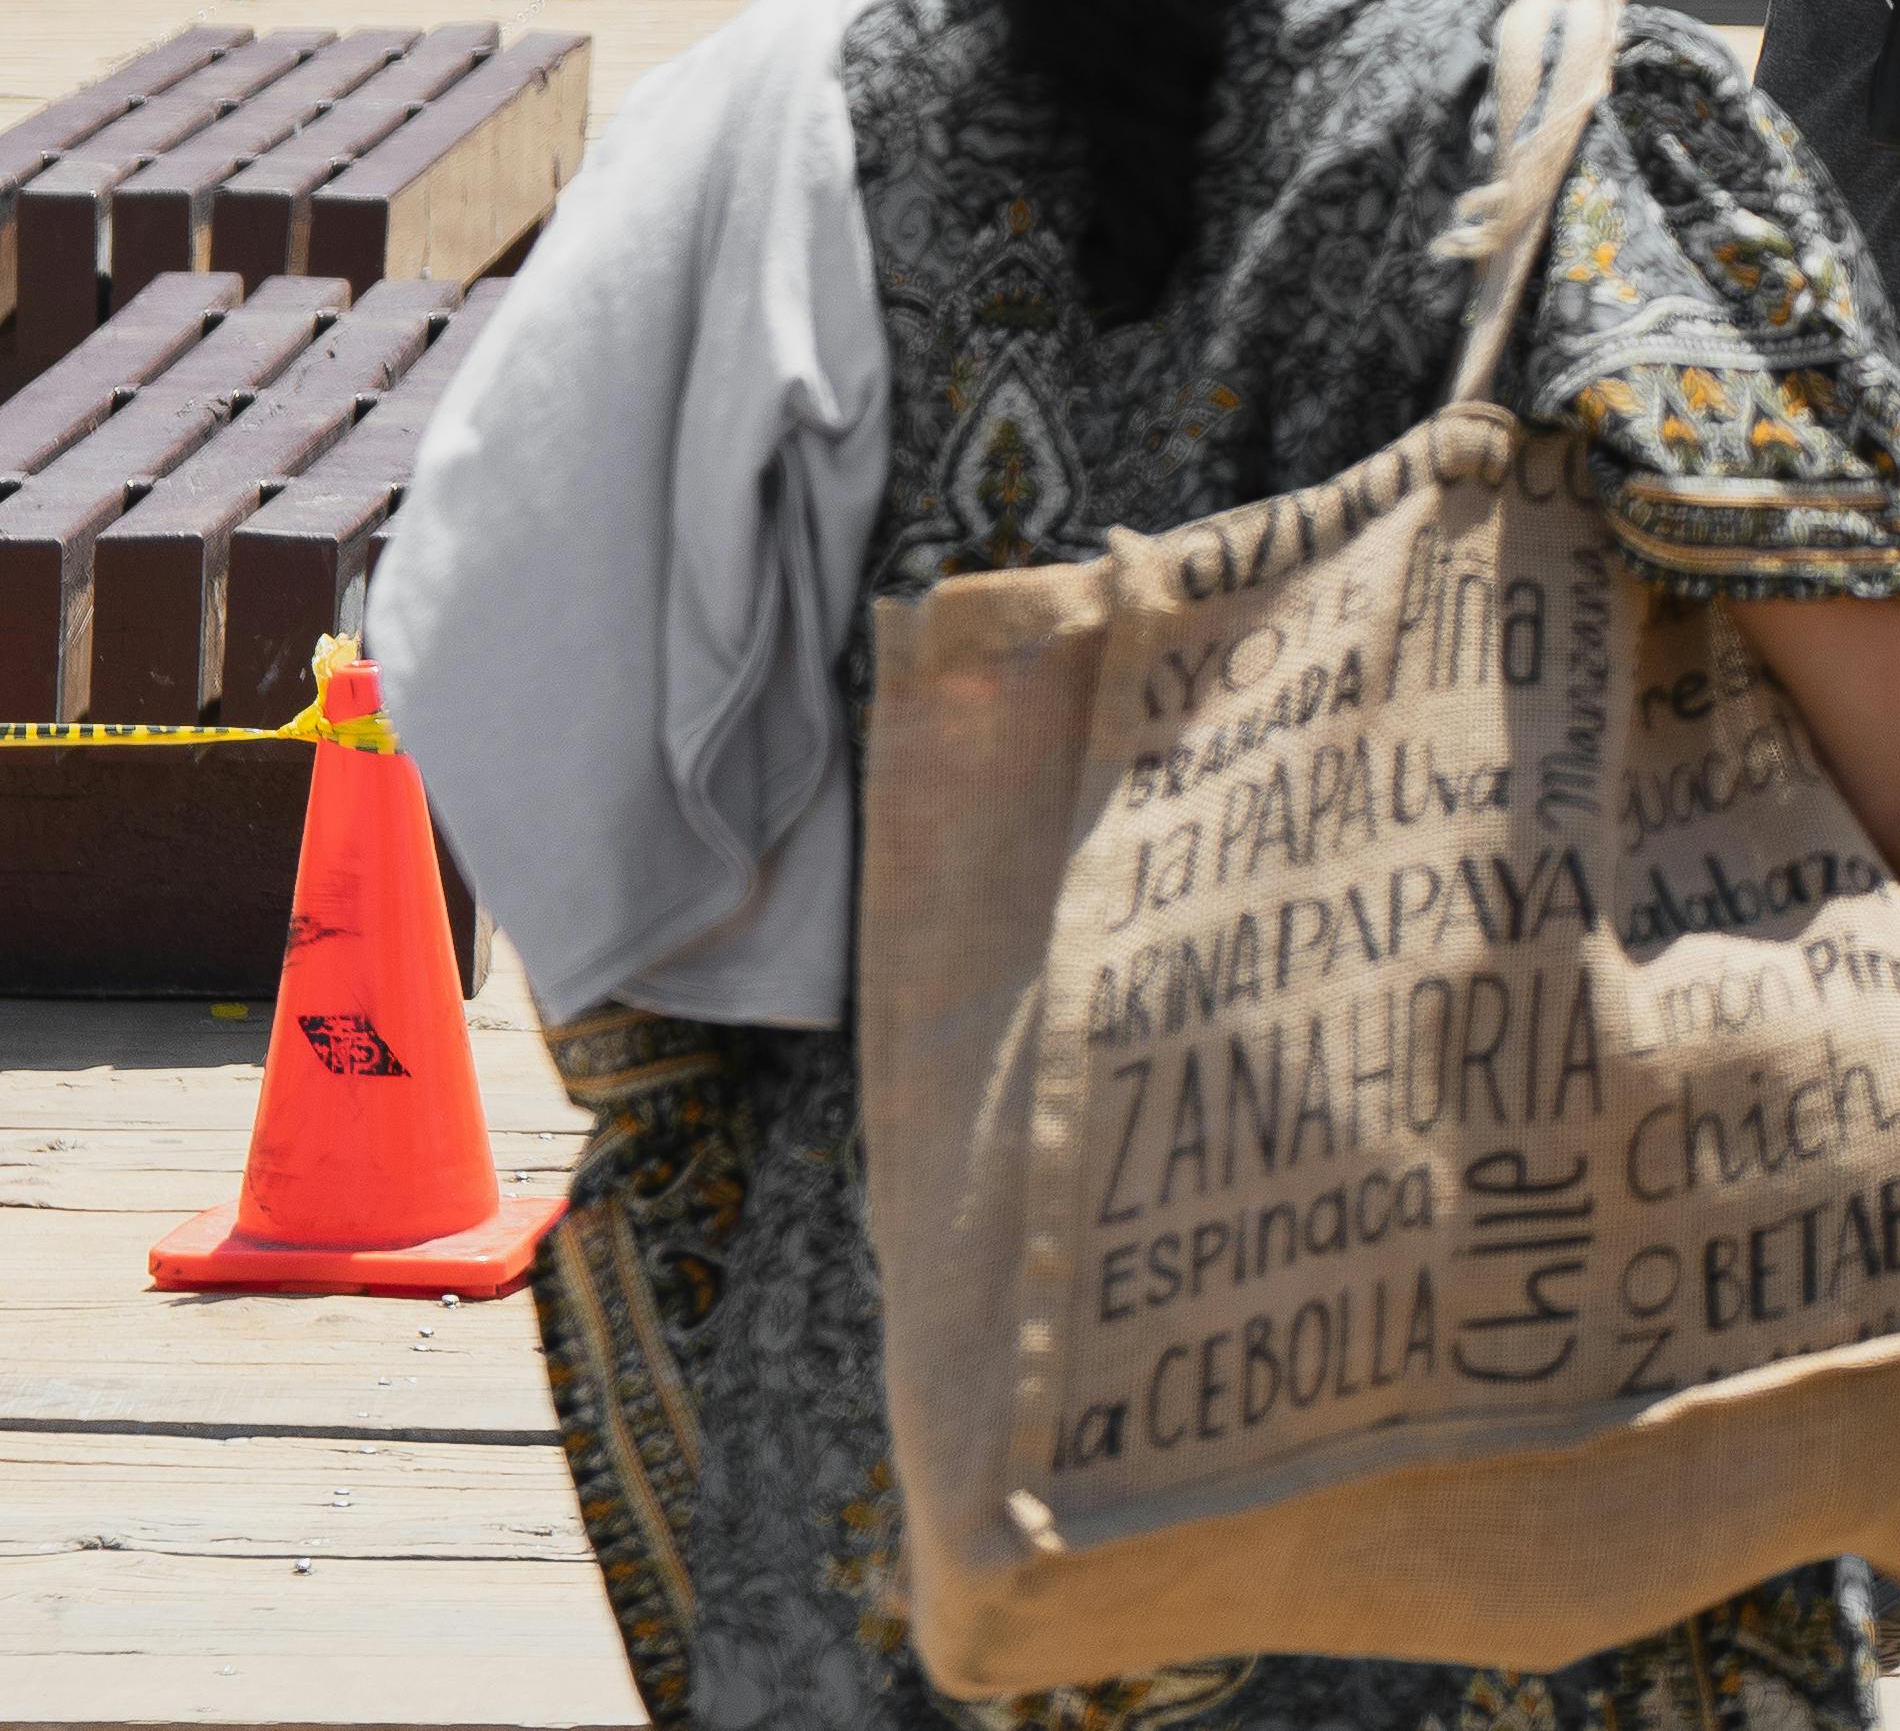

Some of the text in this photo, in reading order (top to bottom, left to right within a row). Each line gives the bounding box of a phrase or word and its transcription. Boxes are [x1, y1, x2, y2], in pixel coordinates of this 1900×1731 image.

[1215, 737, 1378, 884] PAPA
[1275, 843, 1600, 991] PAPAYA
[1098, 967, 1604, 1227] ZANAHORIA
[1146, 1262, 1437, 1449] CEBOLLA
